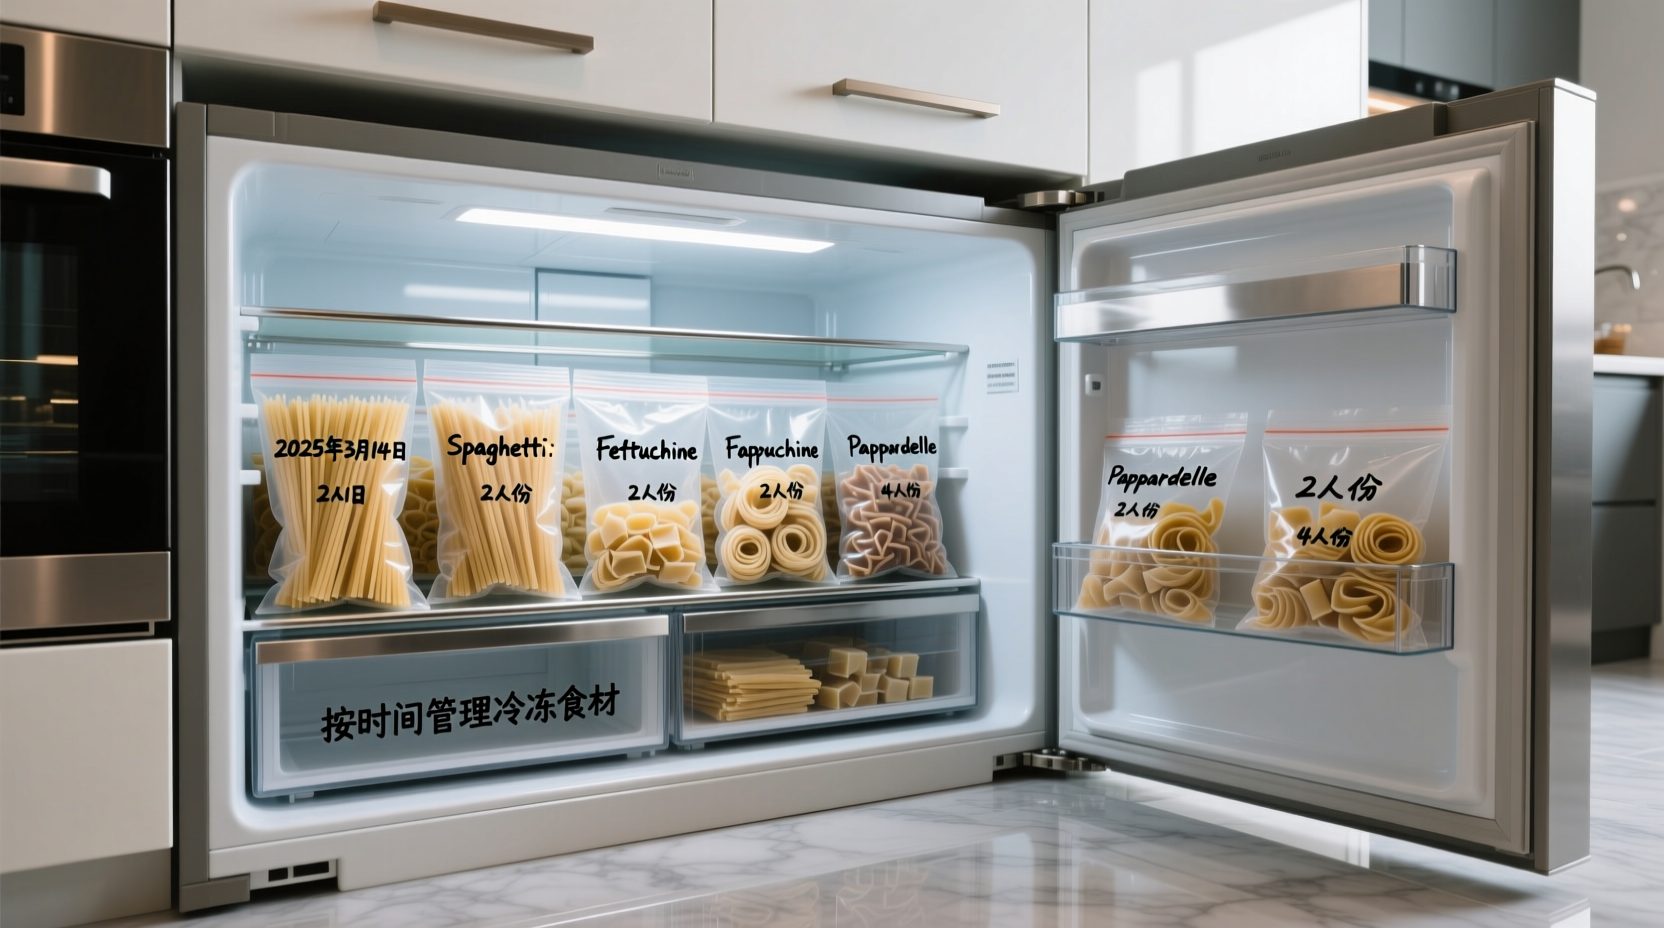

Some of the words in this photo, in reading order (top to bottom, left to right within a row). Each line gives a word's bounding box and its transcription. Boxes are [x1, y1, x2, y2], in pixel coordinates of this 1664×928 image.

[274, 435, 406, 462] 2025年3月14日
[447, 434, 555, 466] Spaghetti:
[596, 434, 698, 461] Fettuchine
[725, 435, 819, 469] Fappuchine
[847, 434, 937, 463] Pappardelle
[628, 482, 677, 502] 2人份
[759, 481, 804, 500] 2人份
[881, 482, 921, 499] 4人份
[1107, 464, 1217, 494] Pappardelle
[1295, 473, 1383, 502] 2人份
[480, 483, 533, 504] 2人份
[1114, 501, 1160, 519] 2人份
[1296, 526, 1353, 548] 4人份
[320, 682, 620, 743] 按时间管理冷冻食材
